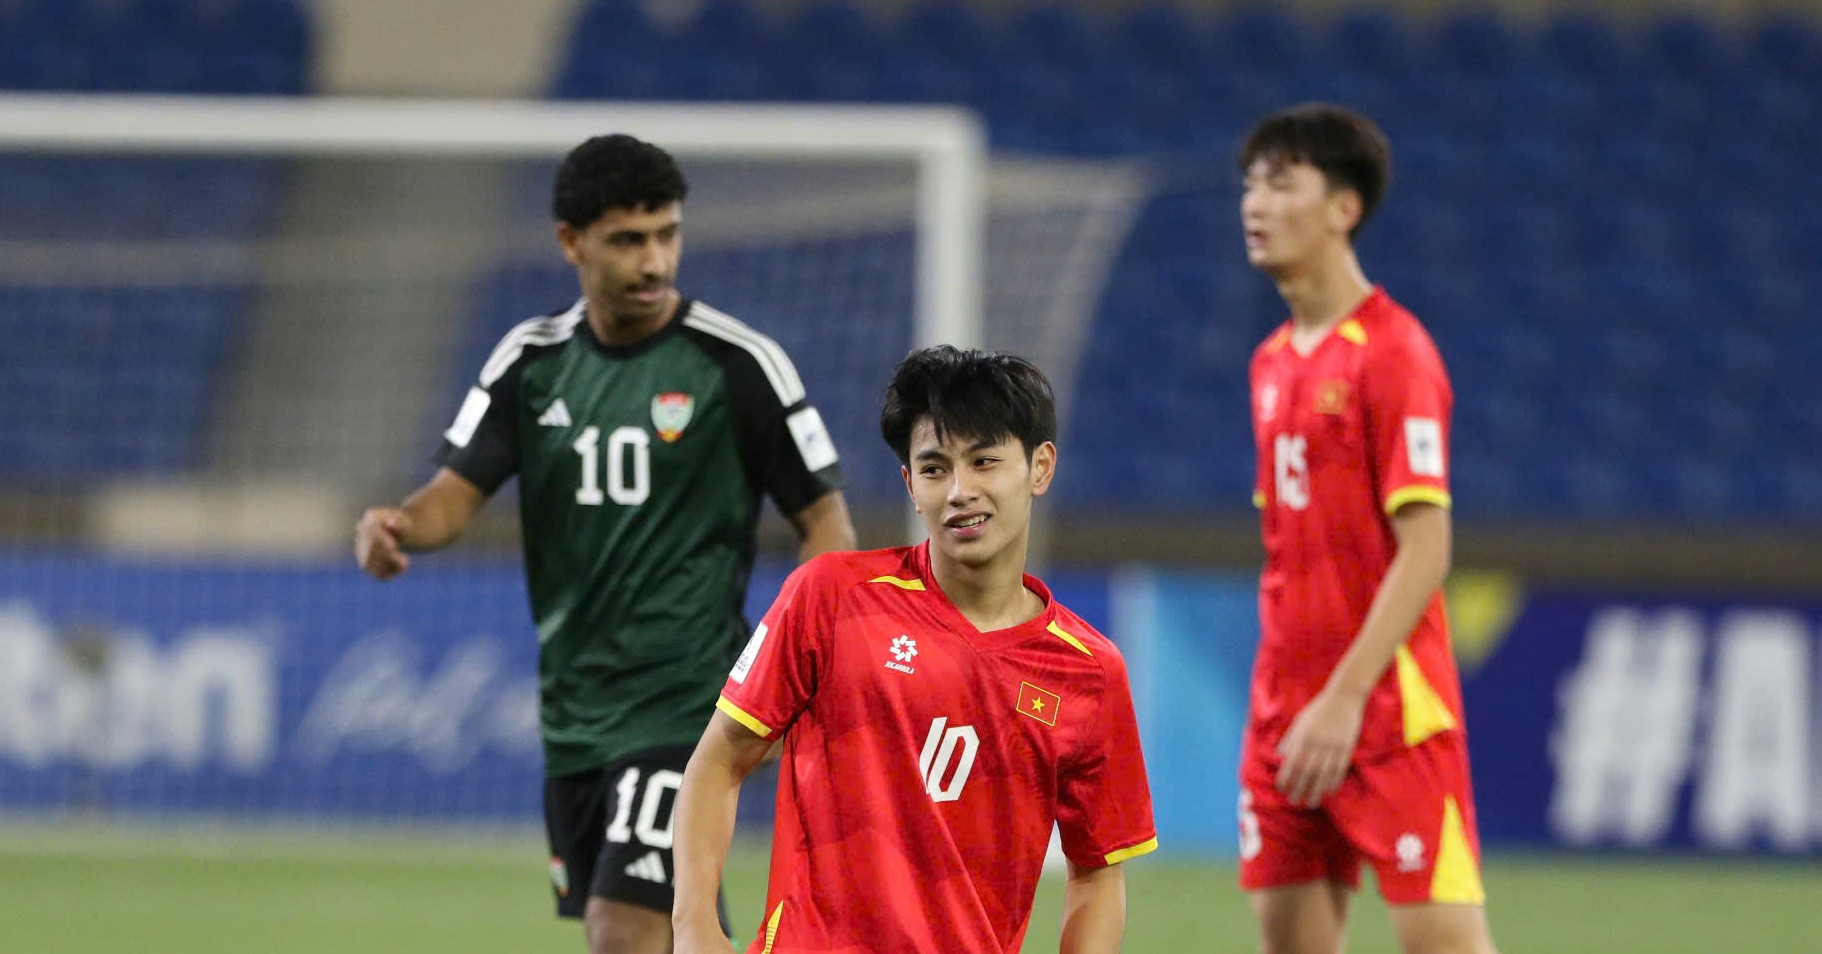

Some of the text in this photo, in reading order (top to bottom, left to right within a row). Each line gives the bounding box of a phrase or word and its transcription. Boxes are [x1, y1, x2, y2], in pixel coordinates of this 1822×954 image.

[573, 426, 651, 506] 10
[919, 716, 980, 803] 10
[1549, 608, 1822, 848] #A
[606, 767, 683, 850] 10
